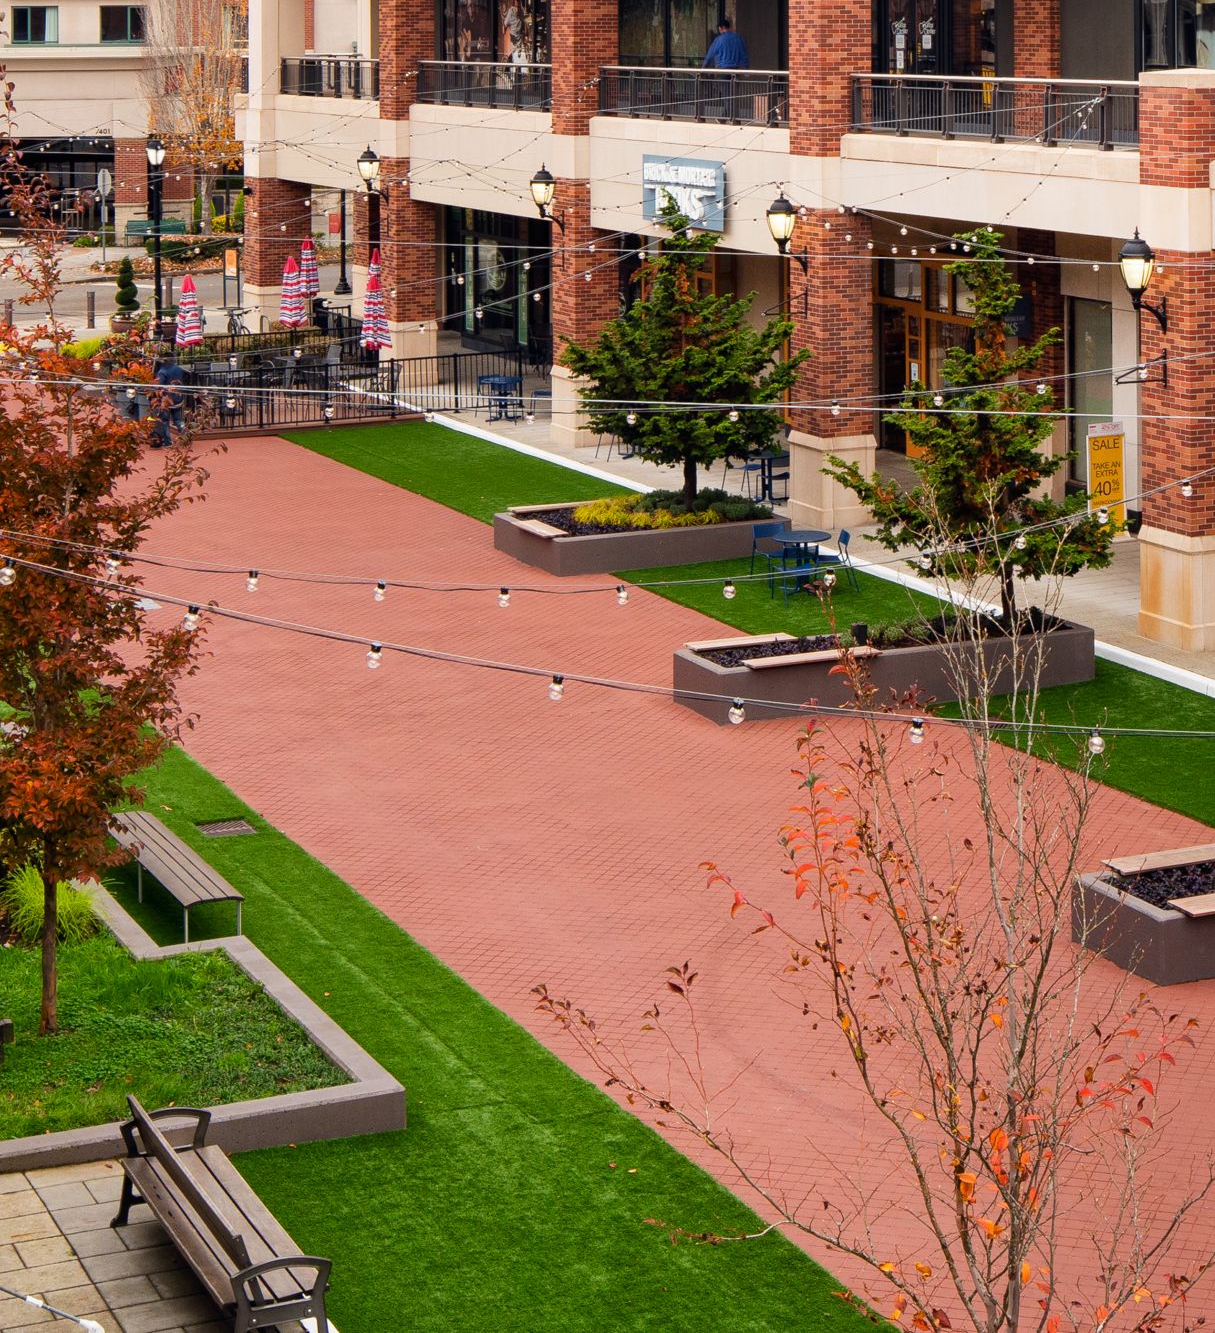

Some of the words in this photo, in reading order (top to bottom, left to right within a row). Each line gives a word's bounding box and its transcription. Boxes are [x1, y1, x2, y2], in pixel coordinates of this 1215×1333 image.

[1092, 438, 1120, 451] SALE
[1093, 462, 1111, 470] TAKE
[1095, 469, 1119, 478] EXTRA
